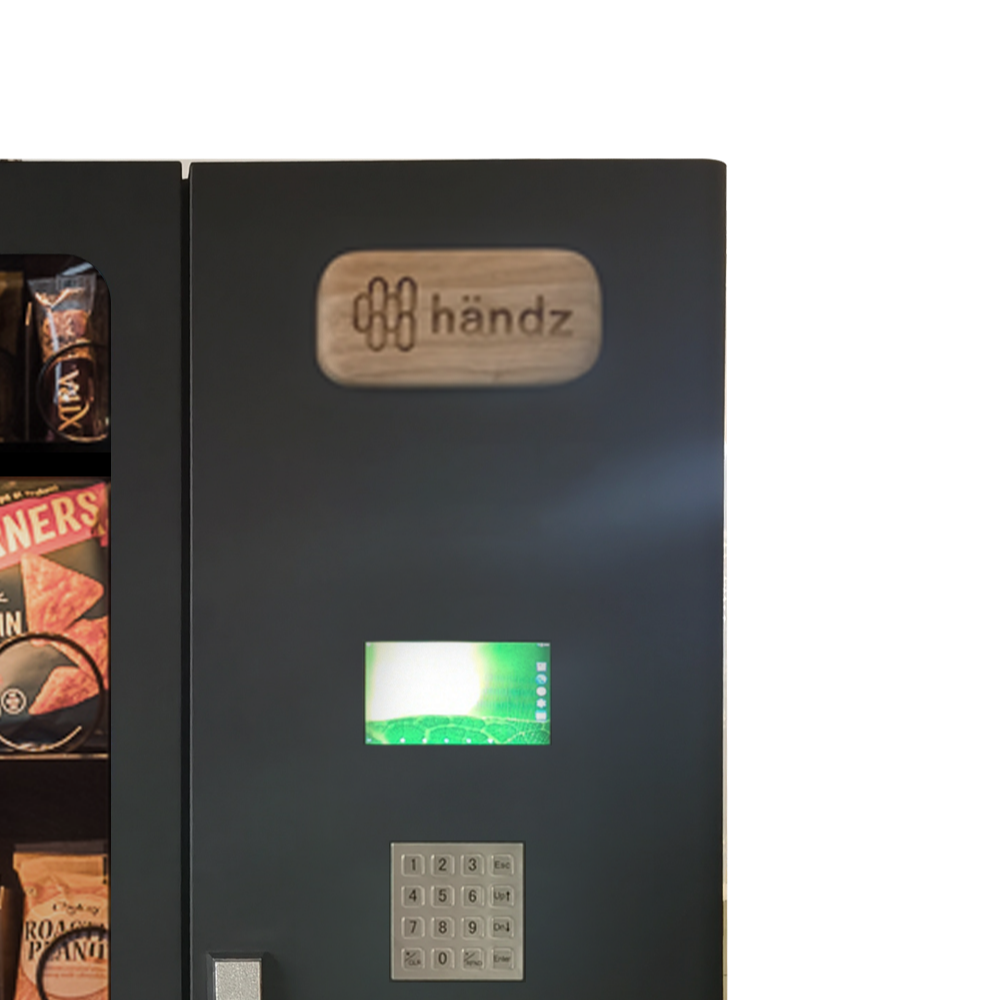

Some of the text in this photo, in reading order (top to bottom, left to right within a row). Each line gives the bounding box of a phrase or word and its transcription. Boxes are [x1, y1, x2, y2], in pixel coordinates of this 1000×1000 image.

[431, 293, 574, 337] händz
[411, 858, 510, 871] 1 2 3 Esc
[409, 889, 417, 902] 4
[438, 889, 447, 902] 5
[468, 889, 477, 903] 6
[410, 920, 417, 934] 7
[438, 920, 447, 934] 8
[468, 920, 477, 934] 9
[438, 951, 447, 965] 0
